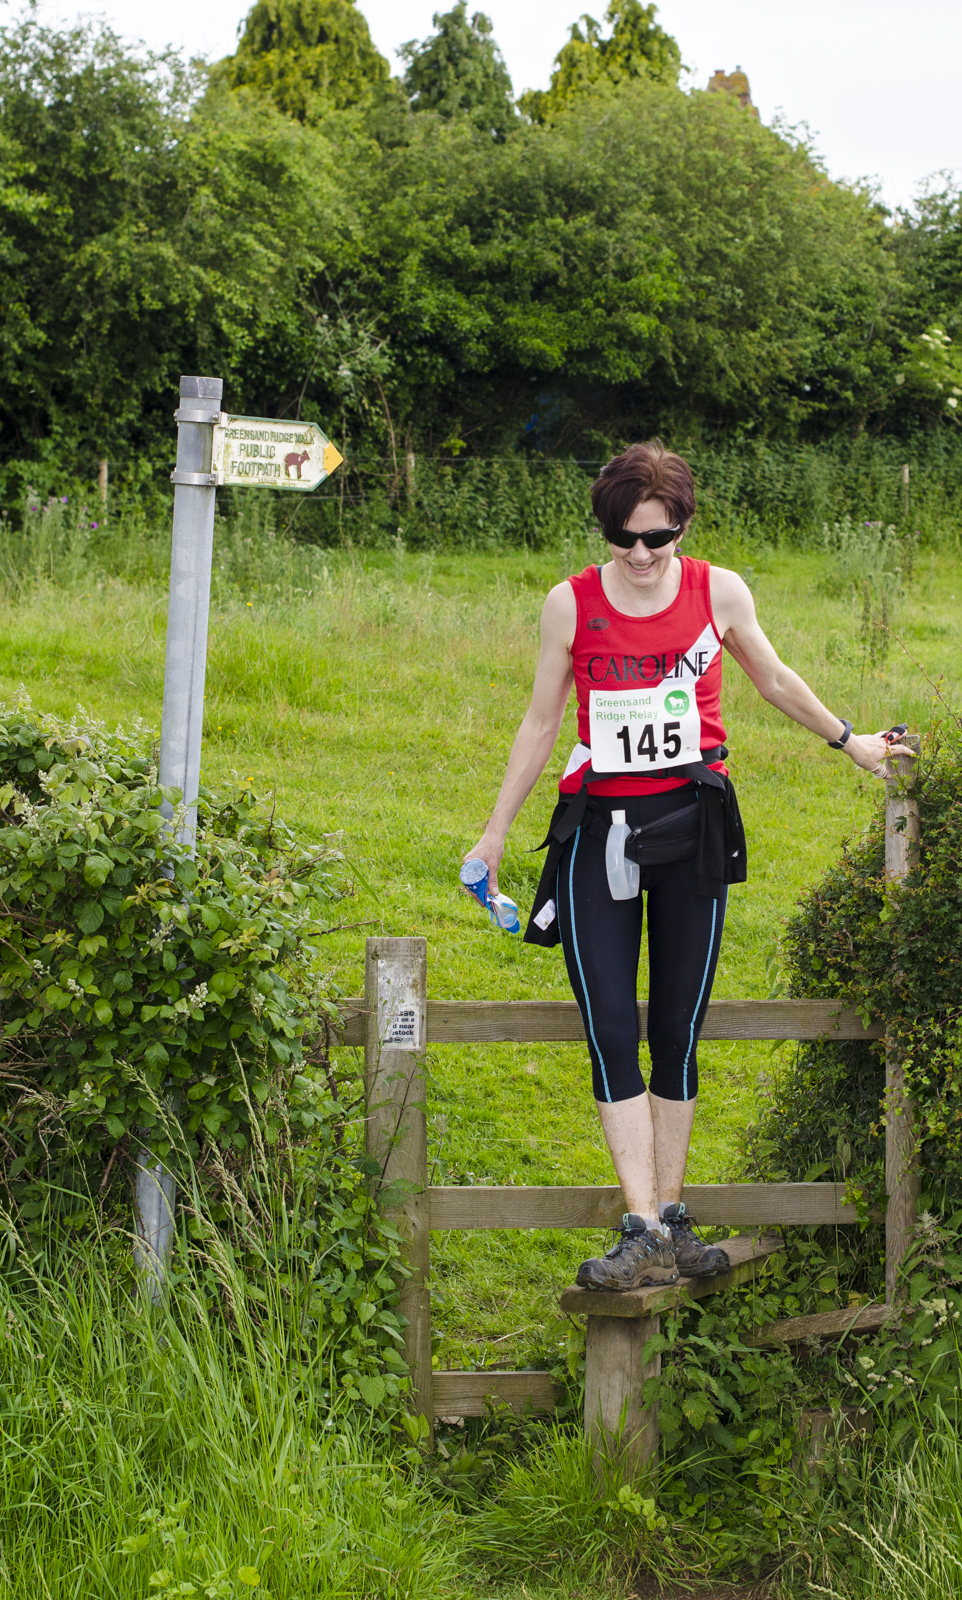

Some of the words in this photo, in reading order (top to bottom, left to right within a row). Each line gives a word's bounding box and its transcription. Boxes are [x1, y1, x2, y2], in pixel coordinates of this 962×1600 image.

[225, 428, 270, 441] GREENSAND
[270, 431, 294, 443] RIDGE
[239, 443, 275, 458] PUBLIC
[231, 461, 281, 477] FOOTPATH
[587, 651, 708, 682] CAROLINE
[595, 696, 651, 707] Greensand
[595, 711, 626, 722] Ridge
[629, 709, 658, 720] Relay
[616, 721, 682, 763] 145
